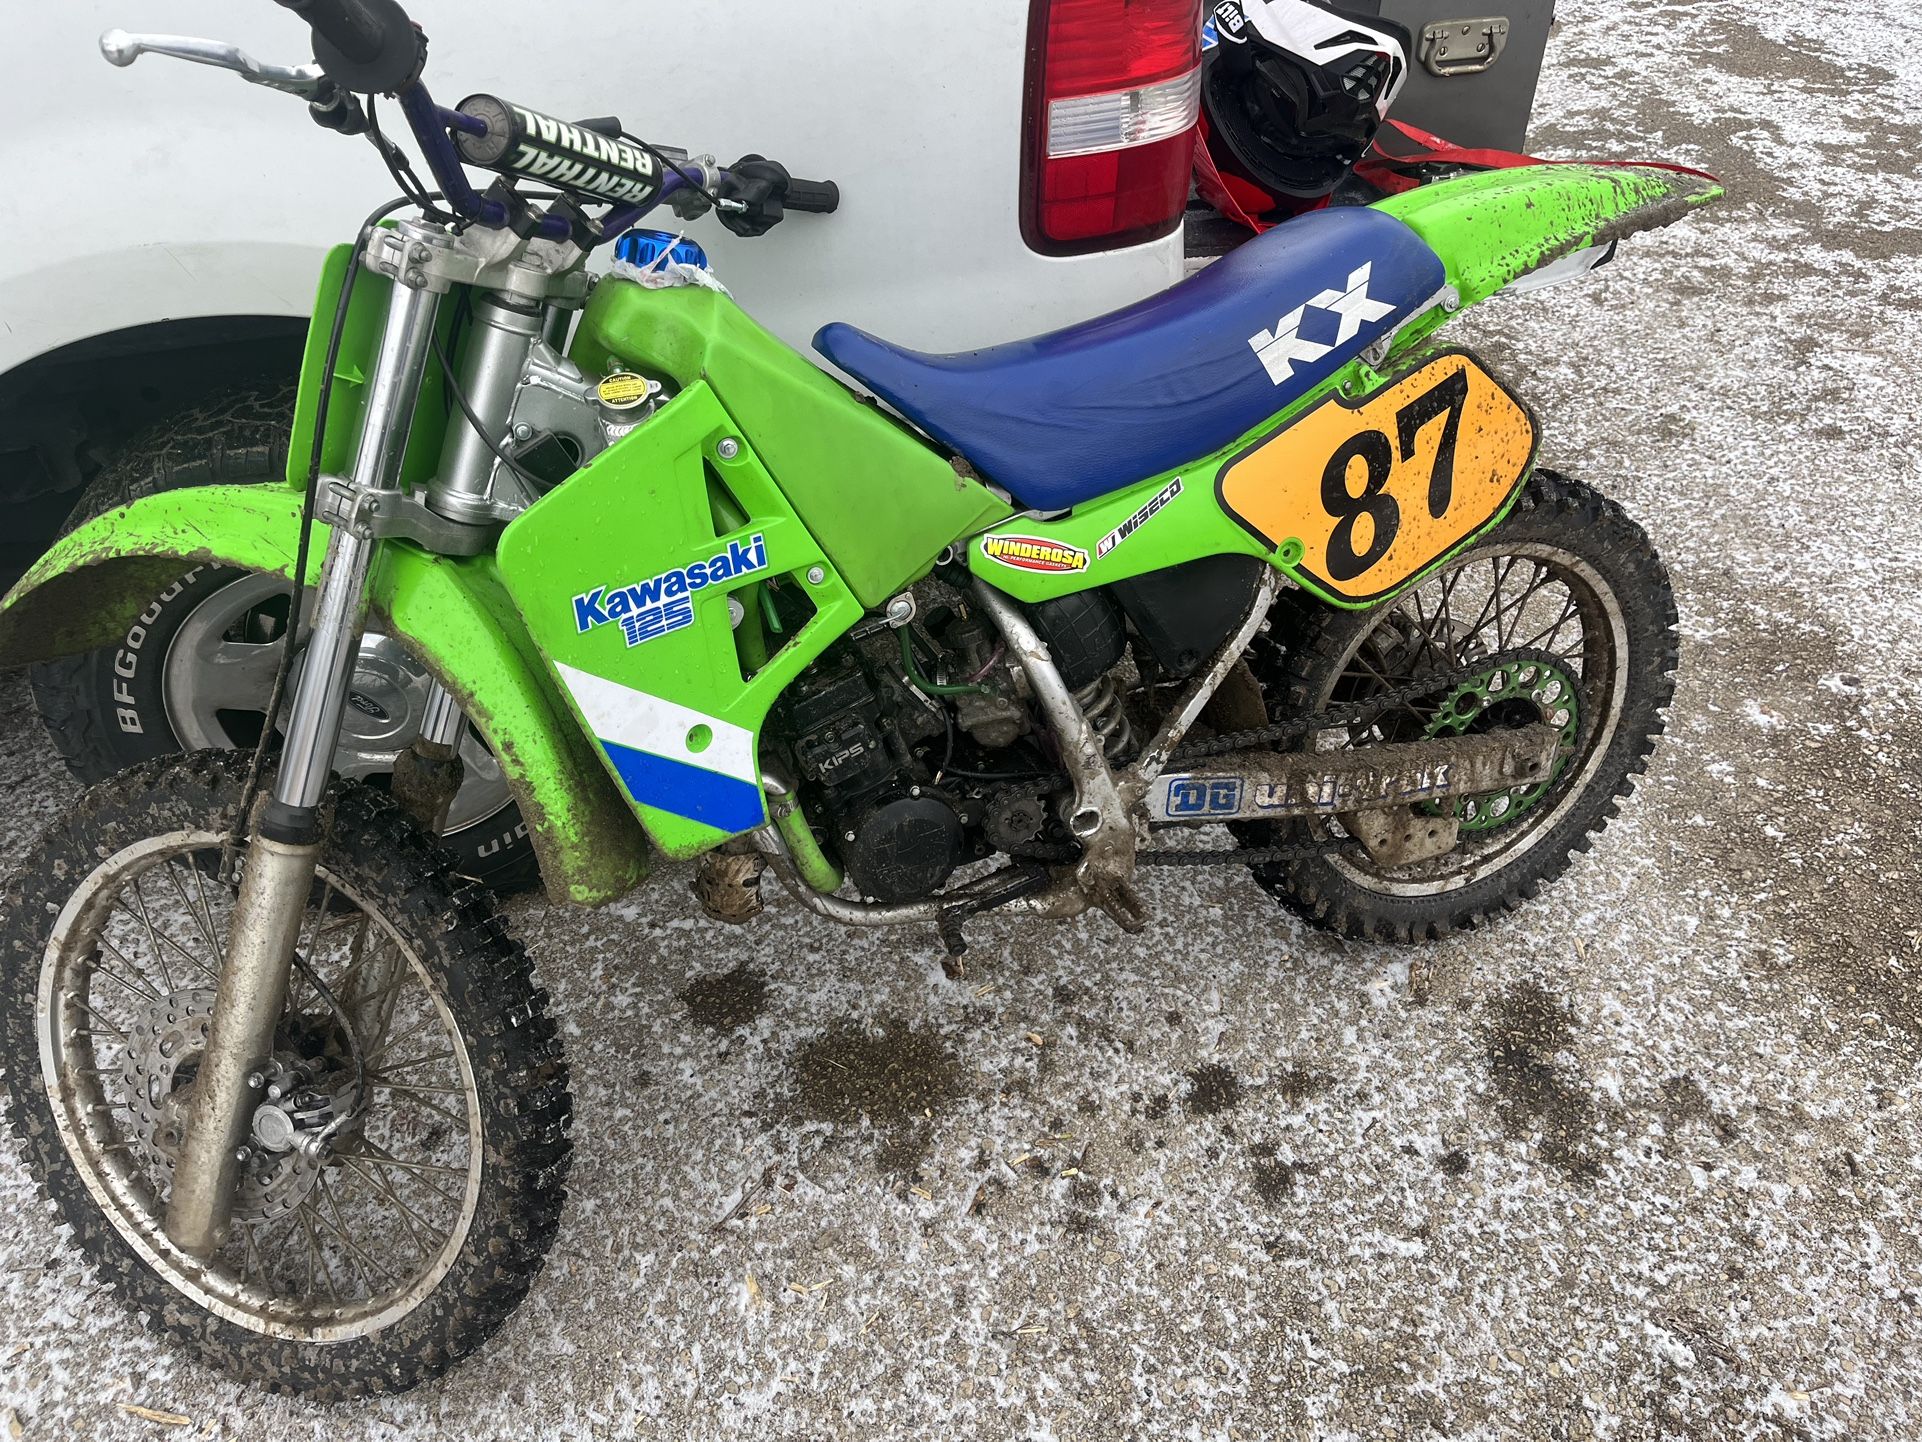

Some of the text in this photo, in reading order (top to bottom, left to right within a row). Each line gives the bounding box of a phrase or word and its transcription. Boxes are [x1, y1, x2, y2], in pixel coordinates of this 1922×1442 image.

[512, 106, 653, 177] RENTHAL
[512, 142, 655, 204] RENTHAL
[1248, 260, 1397, 386] KX
[1320, 366, 1469, 582] 87
[574, 535, 766, 632] Kawasaki
[987, 537, 1084, 569] WINDEROSA
[621, 596, 693, 646] 125
[351, 694, 380, 714] Ford
[818, 742, 865, 774] KIPS
